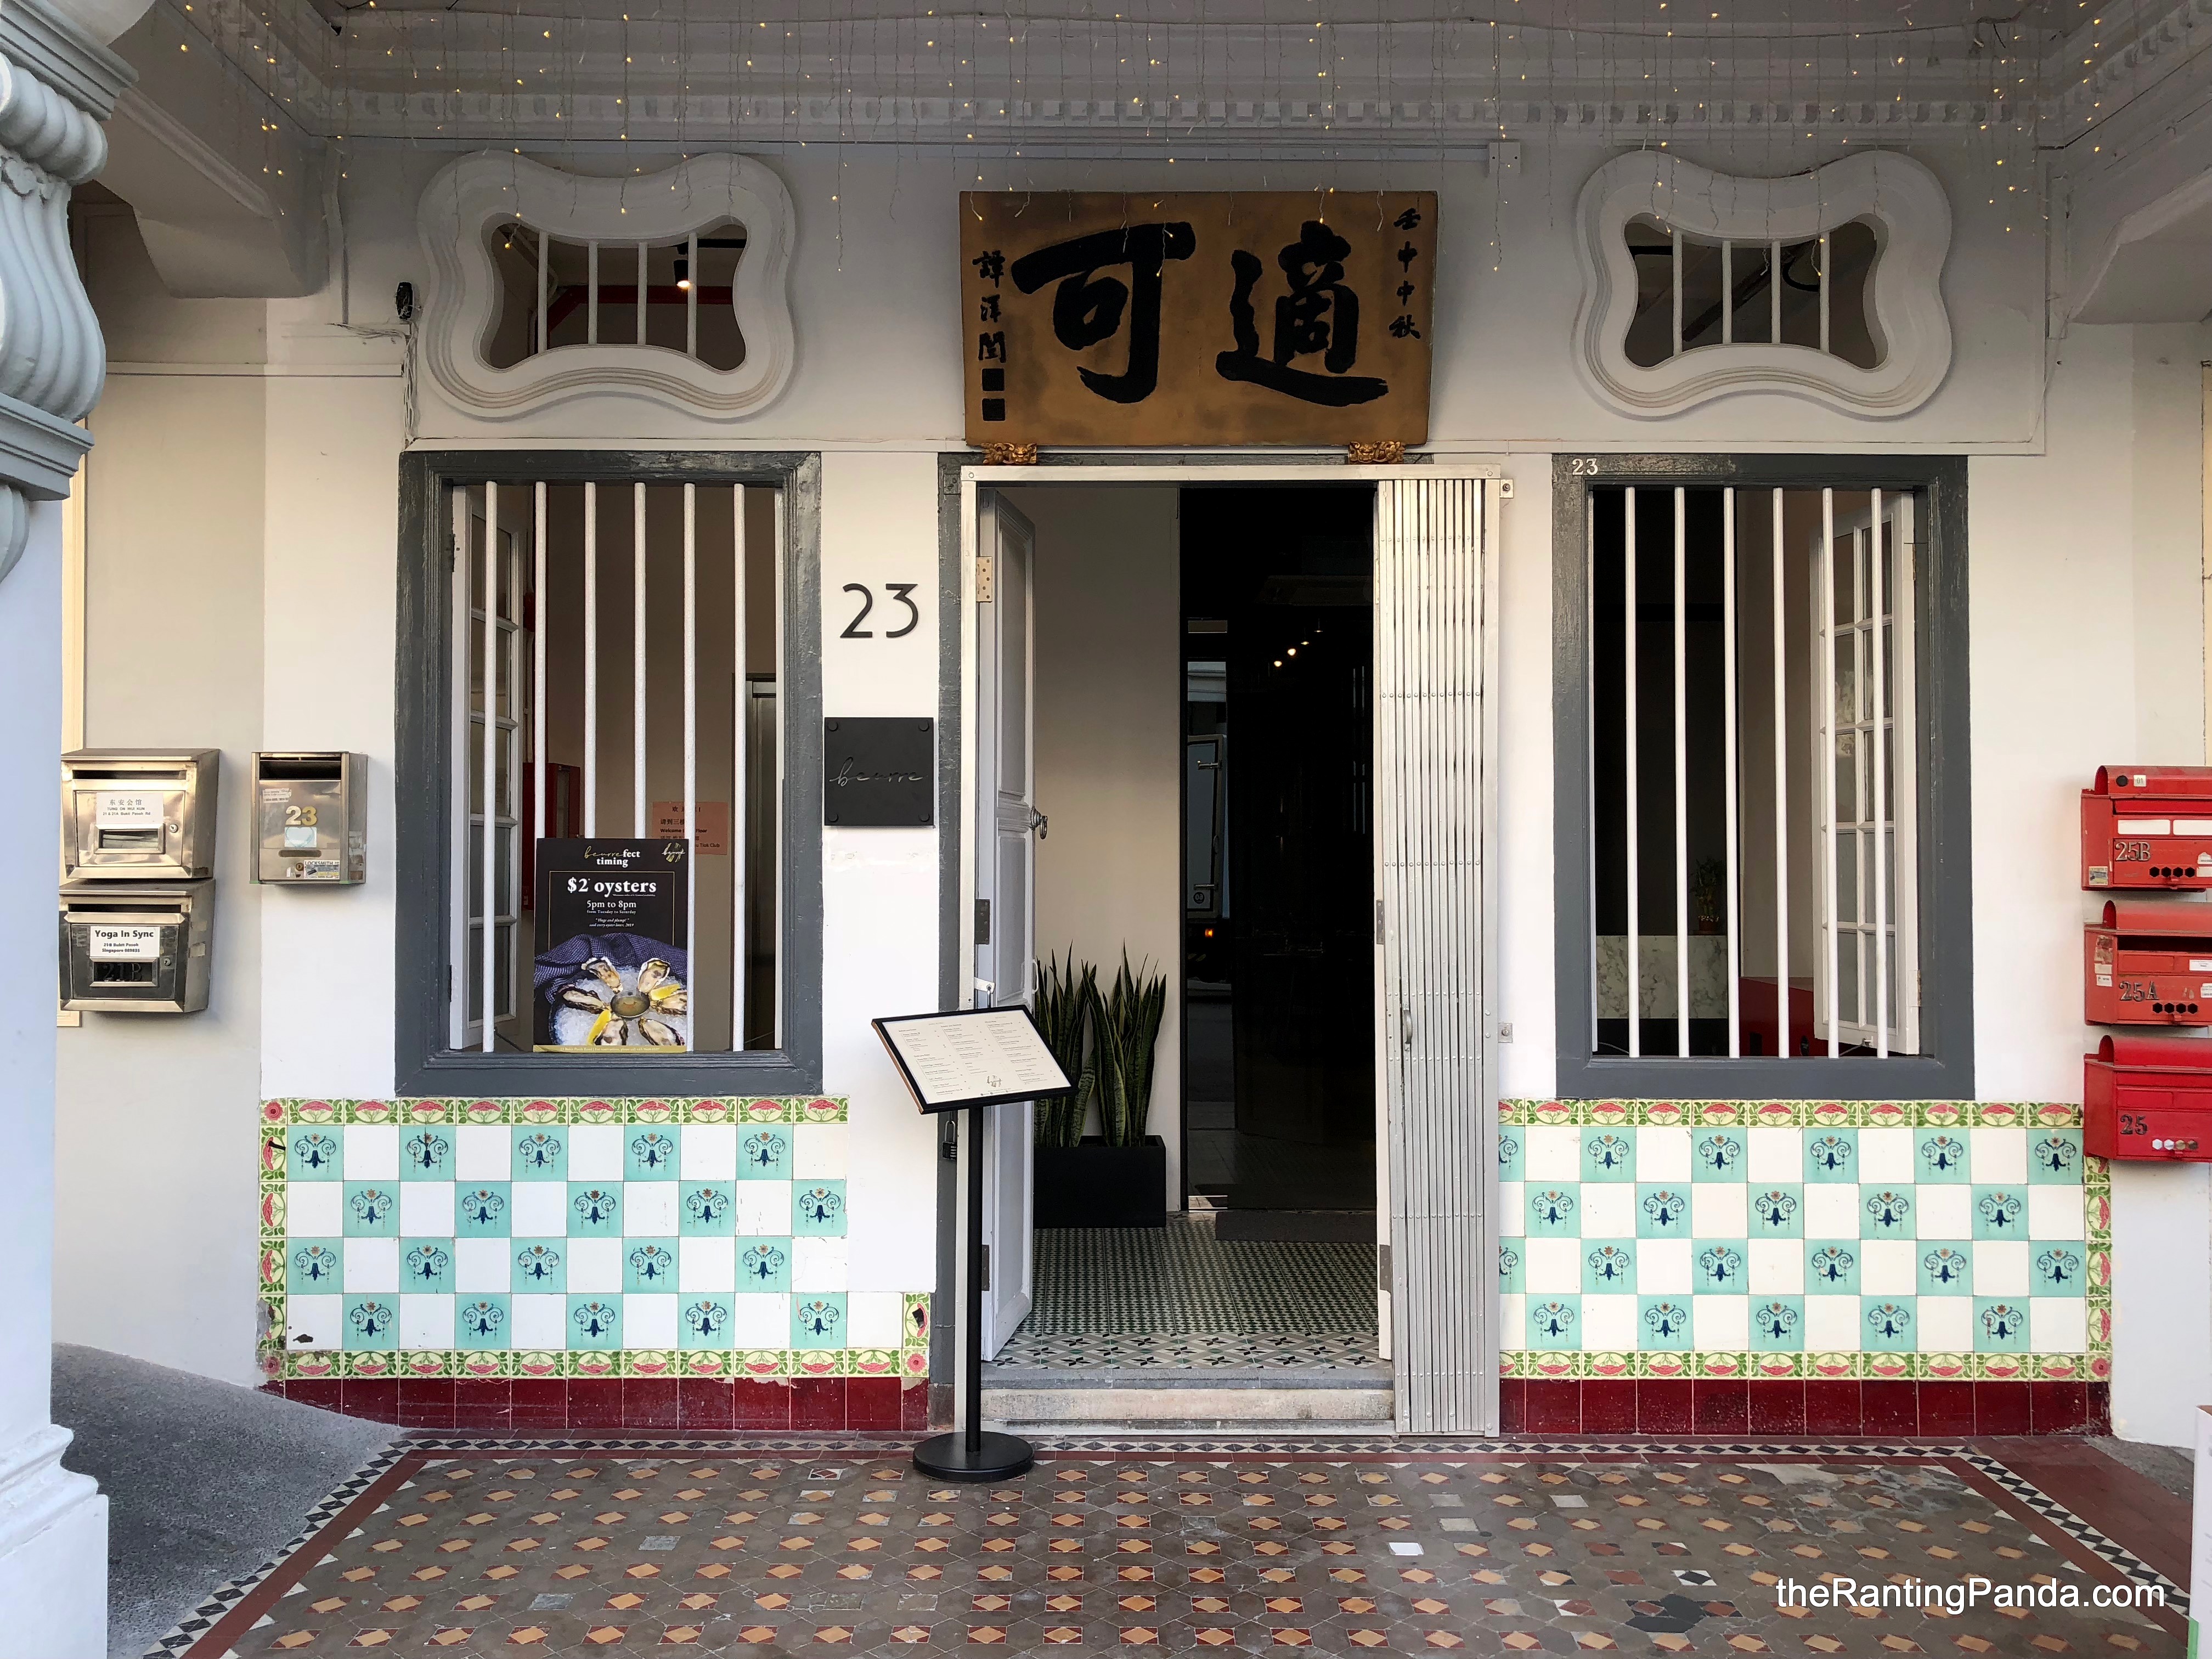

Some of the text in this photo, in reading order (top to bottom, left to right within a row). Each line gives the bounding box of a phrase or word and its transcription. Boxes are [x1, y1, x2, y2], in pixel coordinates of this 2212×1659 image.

[1572, 458, 1599, 475] 23
[840, 583, 918, 638] 23
[830, 757, 928, 786] beurre
[285, 805, 317, 826] 23
[2115, 842, 2151, 861] 25B
[596, 857, 629, 868] timing
[594, 881, 657, 898] oysters
[586, 900, 605, 910] 5pm
[618, 900, 636, 910] 8pm
[94, 930, 118, 939] Yoga
[132, 930, 154, 939] Sync
[2119, 981, 2160, 1001] 25A
[2120, 1114, 2148, 1135] 25
